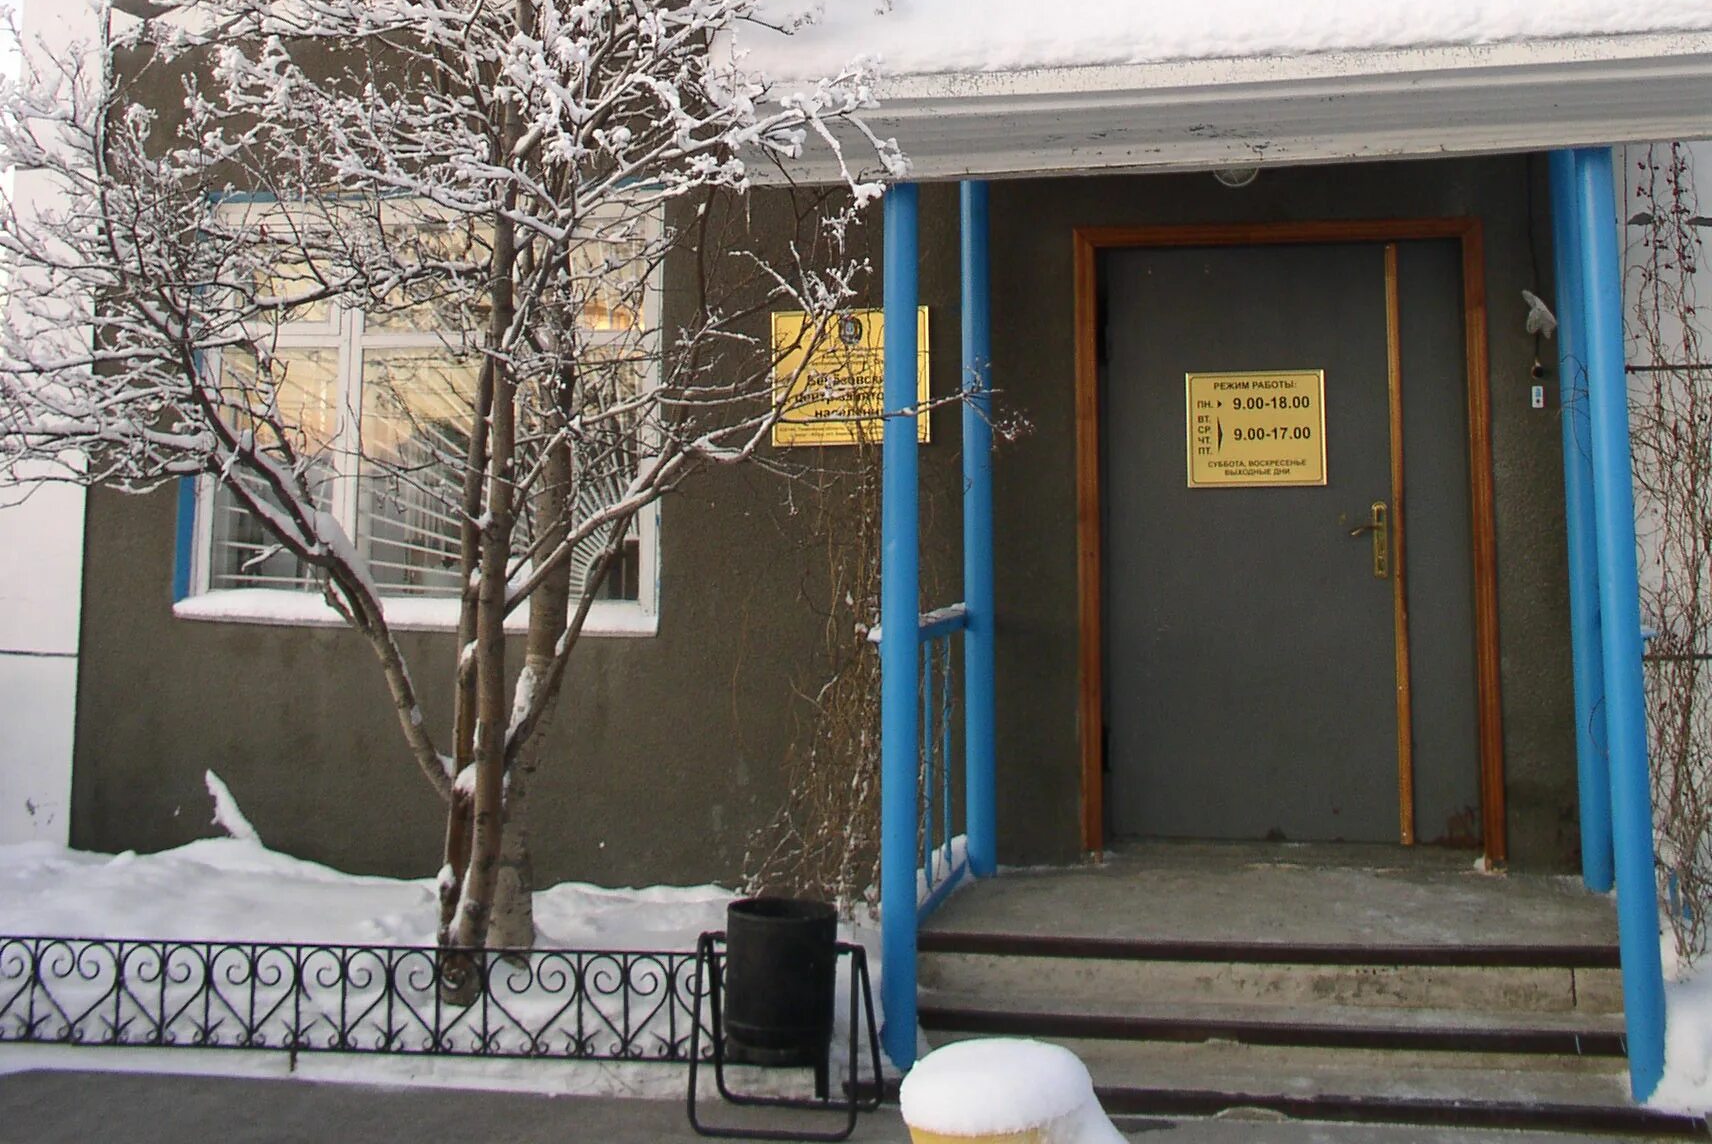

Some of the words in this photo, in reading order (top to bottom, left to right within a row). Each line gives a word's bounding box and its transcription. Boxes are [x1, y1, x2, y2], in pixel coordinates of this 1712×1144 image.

[1213, 381, 1249, 390] РЕЖИМ
[1252, 380, 1297, 390] РАБОТЫ:
[1197, 400, 1213, 409] ПН.
[1233, 395, 1310, 410] 9.00-18.00
[1233, 426, 1311, 441] 9.00-17.00
[1198, 447, 1213, 455] ПТ.
[1208, 460, 1247, 469] СУББОТА,
[1248, 458, 1307, 468] ВОСКРЕСЕНЬЕ
[1224, 468, 1271, 476] ВЫХОДНЫЕ
[1273, 467, 1291, 476] ДНИ
